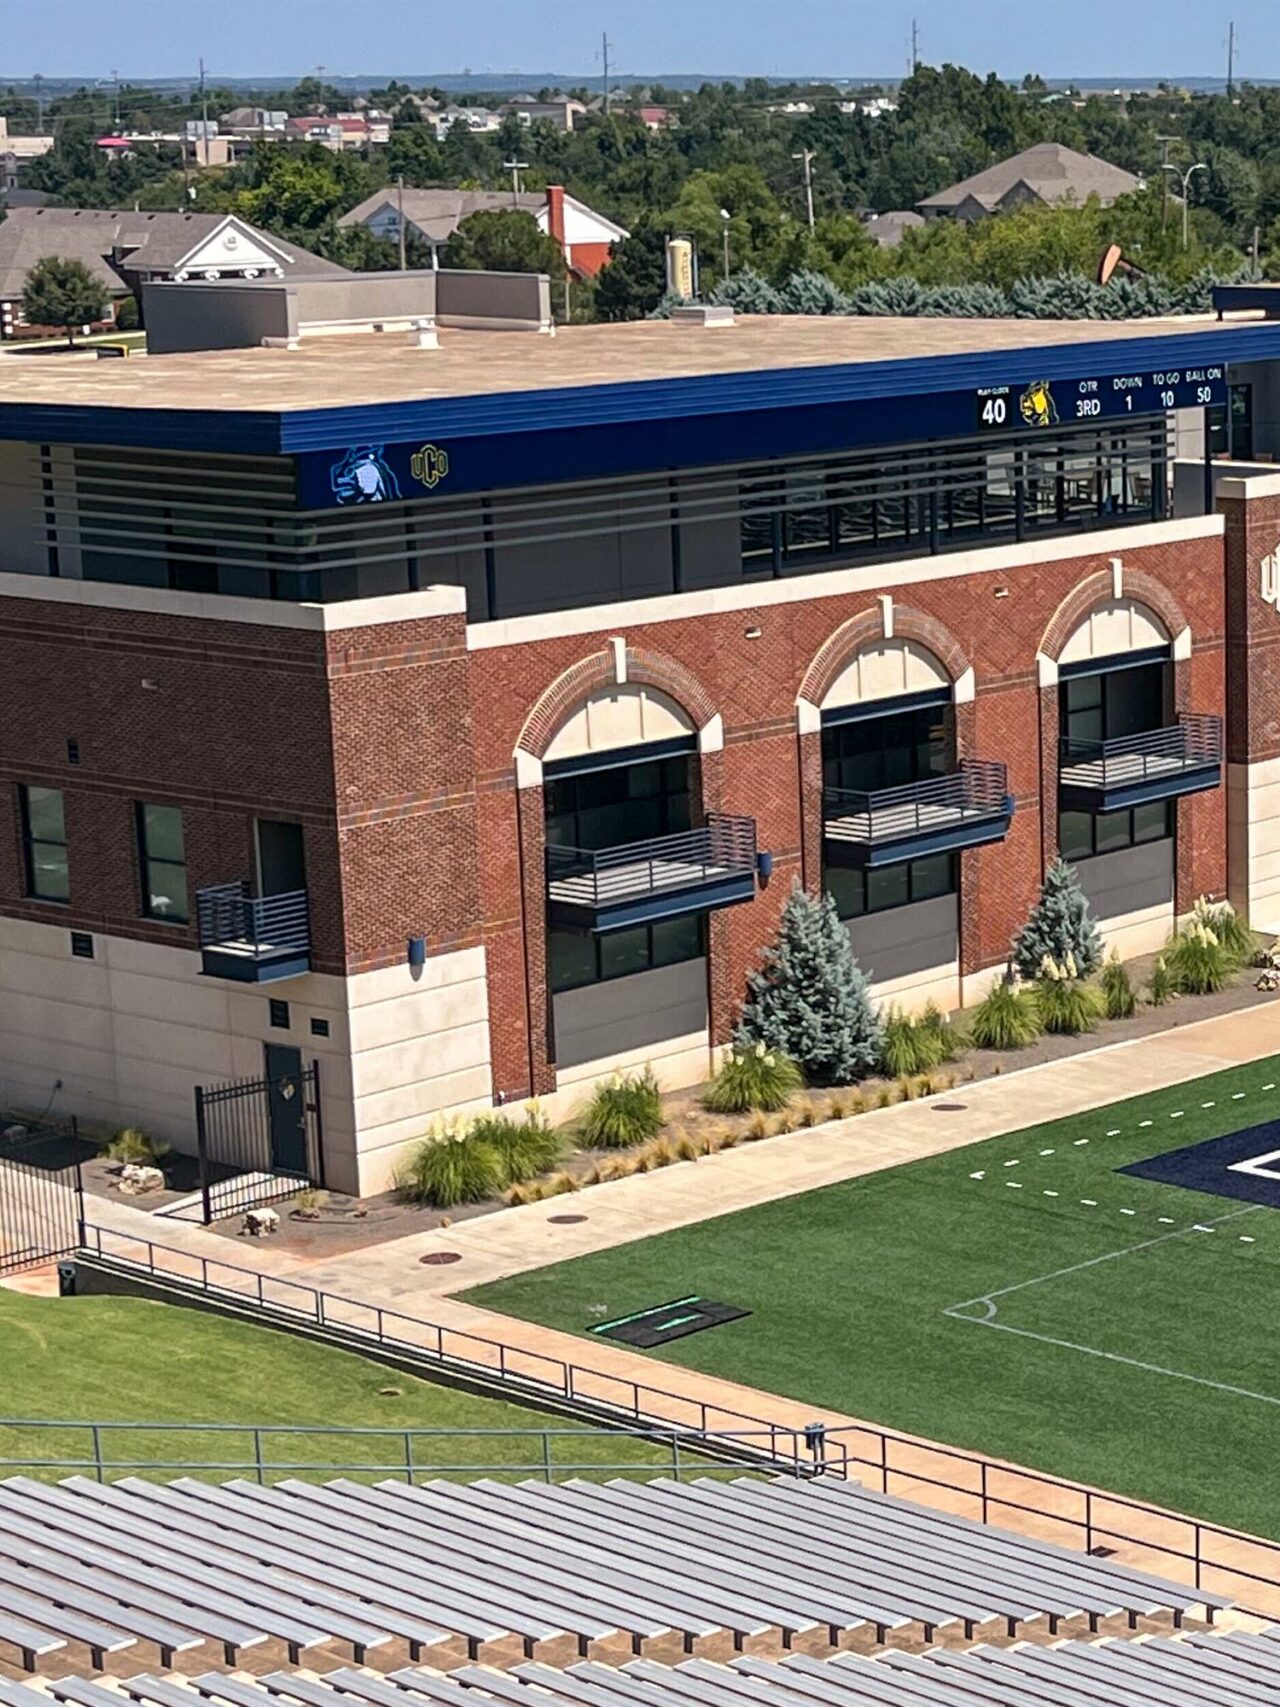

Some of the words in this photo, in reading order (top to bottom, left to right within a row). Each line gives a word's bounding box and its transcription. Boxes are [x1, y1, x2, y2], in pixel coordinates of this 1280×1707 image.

[1125, 395, 1132, 411] 1
[1161, 390, 1174, 407] 10
[1197, 386, 1211, 403] 50
[983, 398, 1006, 424] 40
[1076, 399, 1101, 417] 3RD
[410, 444, 449, 489] UCO
